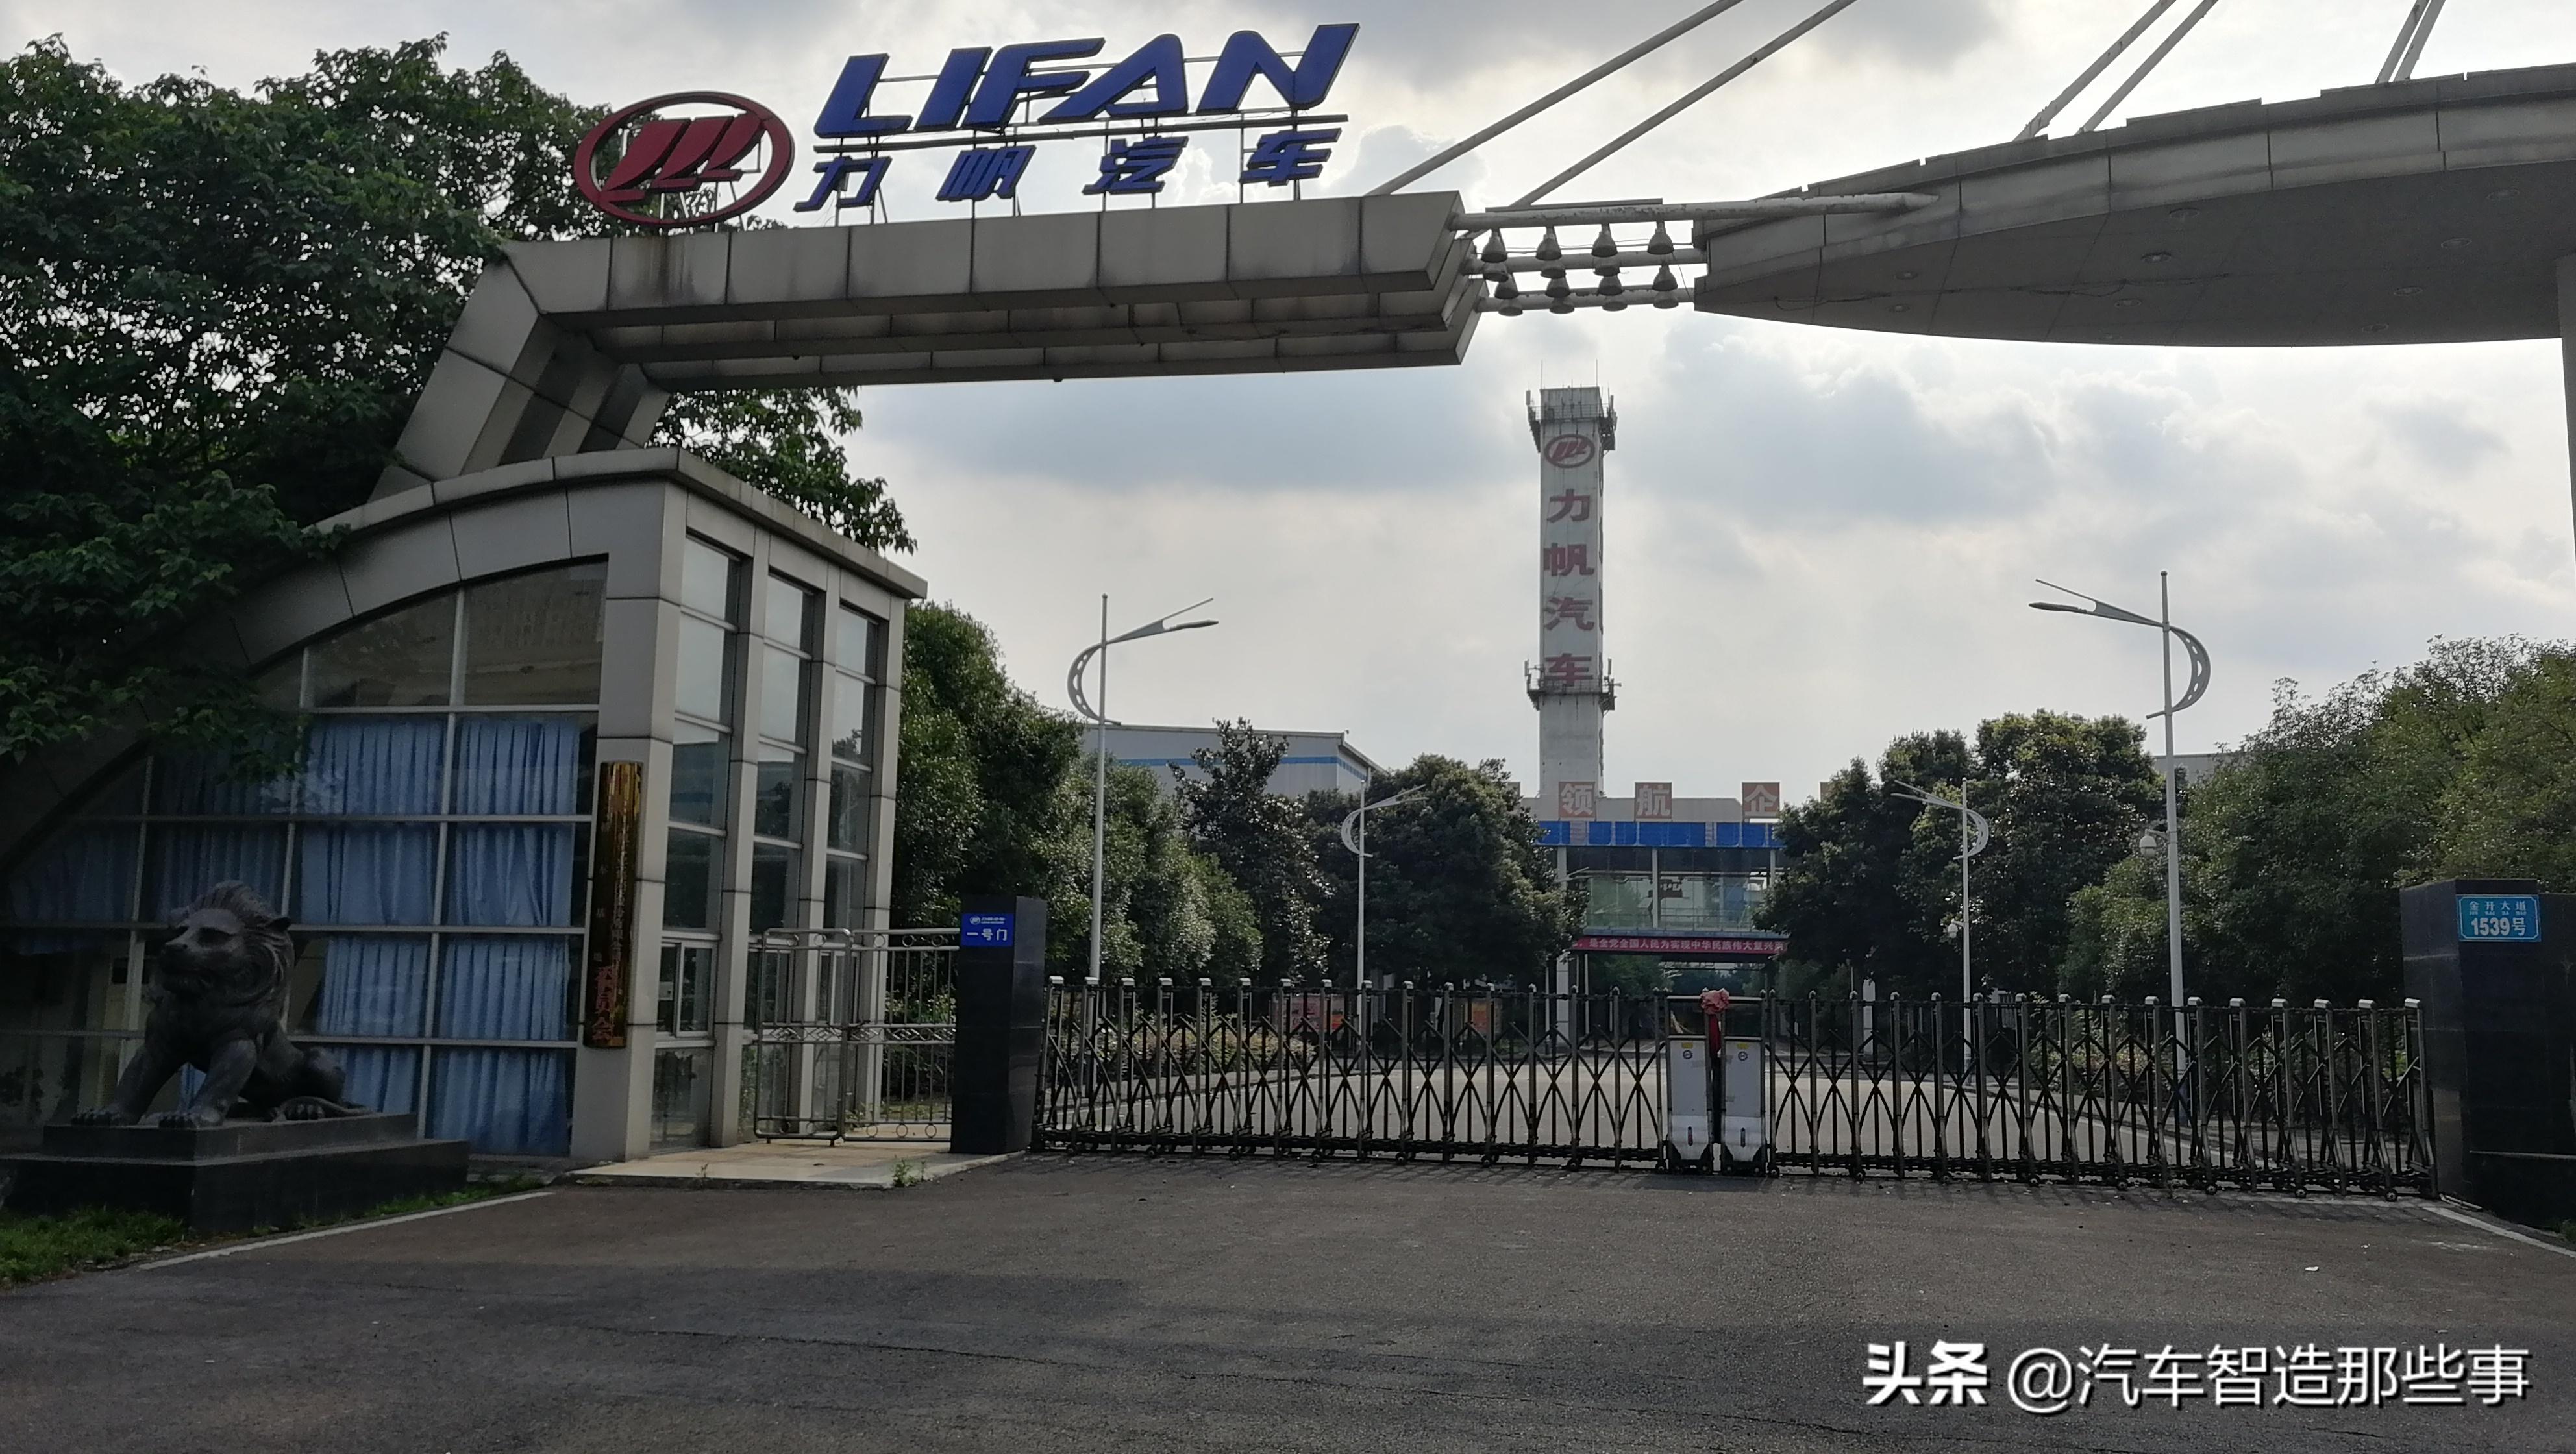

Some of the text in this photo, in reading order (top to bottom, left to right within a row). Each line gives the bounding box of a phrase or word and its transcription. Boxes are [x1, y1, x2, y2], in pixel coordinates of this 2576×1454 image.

[813, 23, 1361, 138] LIFAN
[793, 127, 1342, 212] 力帆汽车
[1542, 488, 1595, 687] 力帆汽车
[2468, 900, 2527, 911] 金开大道
[2471, 917, 2527, 937] 1539号
[967, 928, 1008, 941] 一号门
